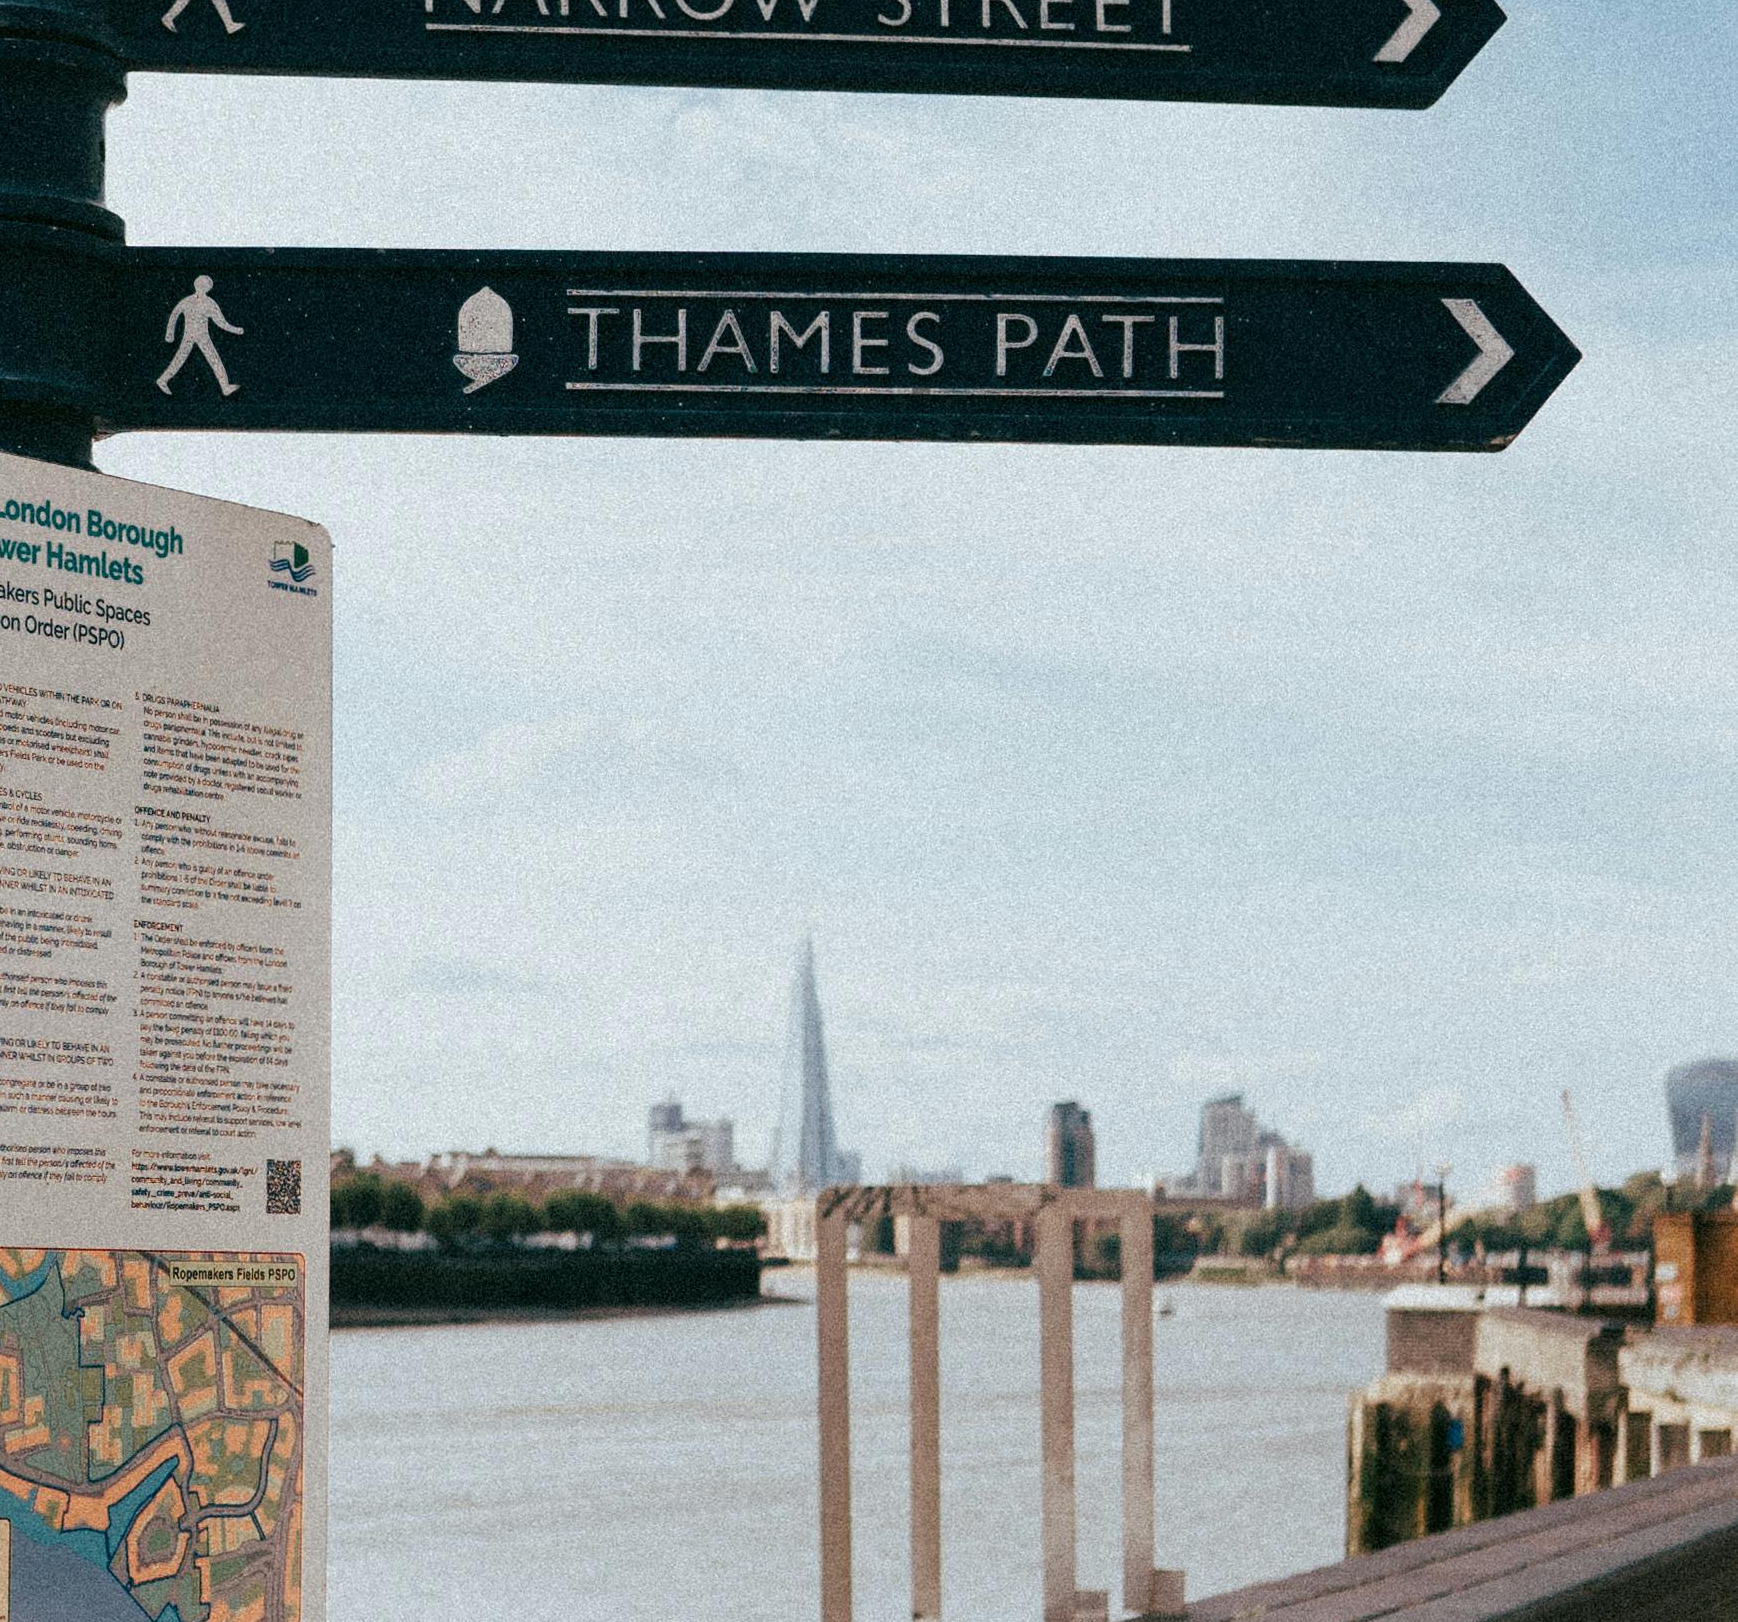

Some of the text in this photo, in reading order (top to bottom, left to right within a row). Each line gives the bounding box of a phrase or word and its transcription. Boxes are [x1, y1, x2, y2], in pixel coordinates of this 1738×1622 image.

[567, 308, 1224, 378] THAMES PATH
[87, 509, 184, 558] Borough
[47, 540, 144, 585] Hamlets
[44, 589, 92, 615] Public
[96, 599, 151, 626] Spaces
[25, 615, 70, 640] Order
[73, 622, 125, 650] (PSPO)
[173, 1267, 296, 1282] Ropemakers Fields PSPO
